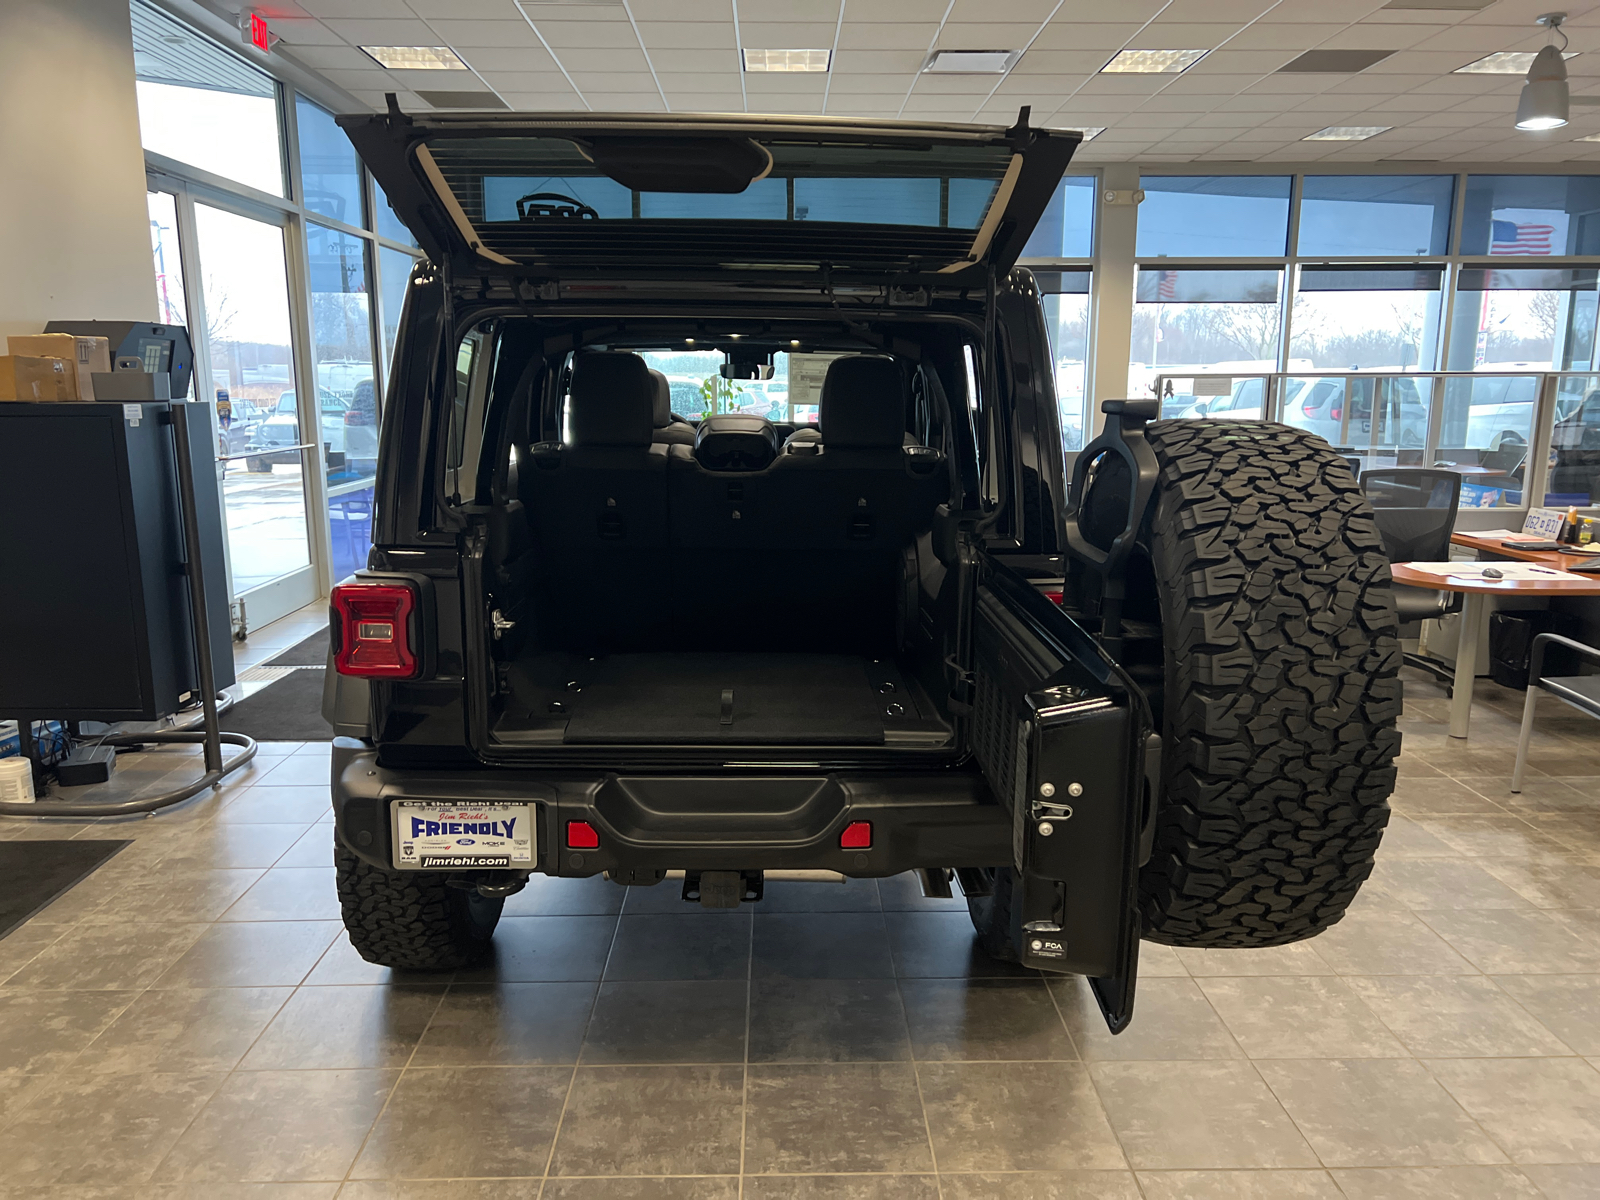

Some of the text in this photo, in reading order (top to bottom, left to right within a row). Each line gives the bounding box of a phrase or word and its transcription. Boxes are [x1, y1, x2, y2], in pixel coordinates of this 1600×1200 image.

[251, 12, 268, 51] EXIT
[438, 812, 489, 821] Jim Riehl's
[411, 816, 517, 839] FRIENDLY
[423, 857, 508, 867] jimriehl.com
